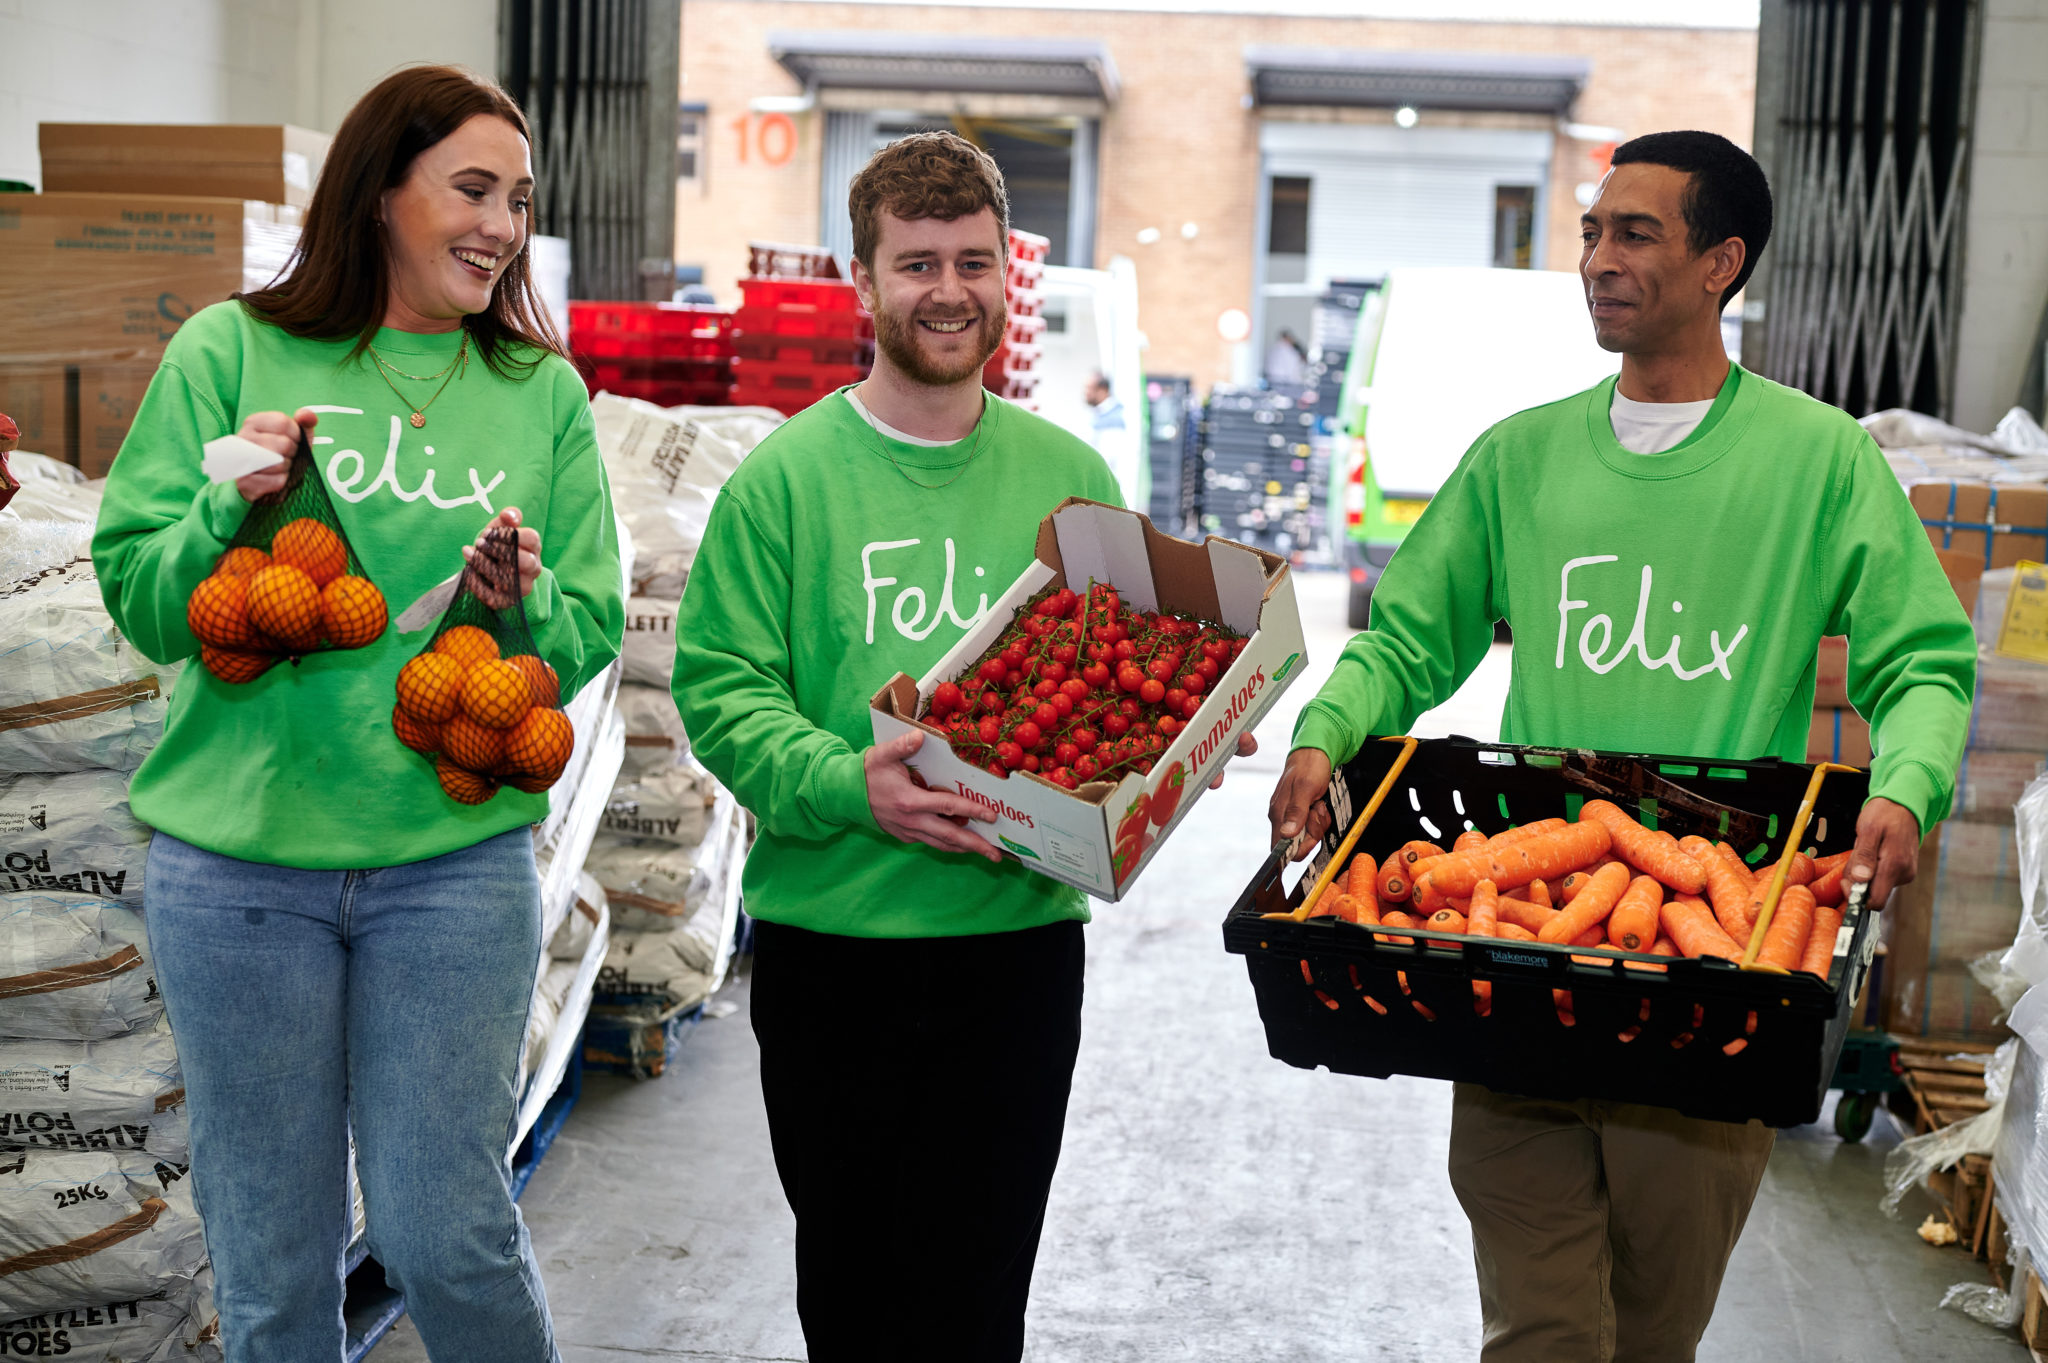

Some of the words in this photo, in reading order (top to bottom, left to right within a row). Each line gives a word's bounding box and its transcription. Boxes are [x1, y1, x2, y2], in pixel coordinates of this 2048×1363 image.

[728, 111, 798, 168] 10
[861, 537, 989, 645] Feli
[1555, 554, 1749, 681] Felix
[1187, 664, 1265, 777] Tomatoes
[1491, 950, 1549, 966] blakemore
